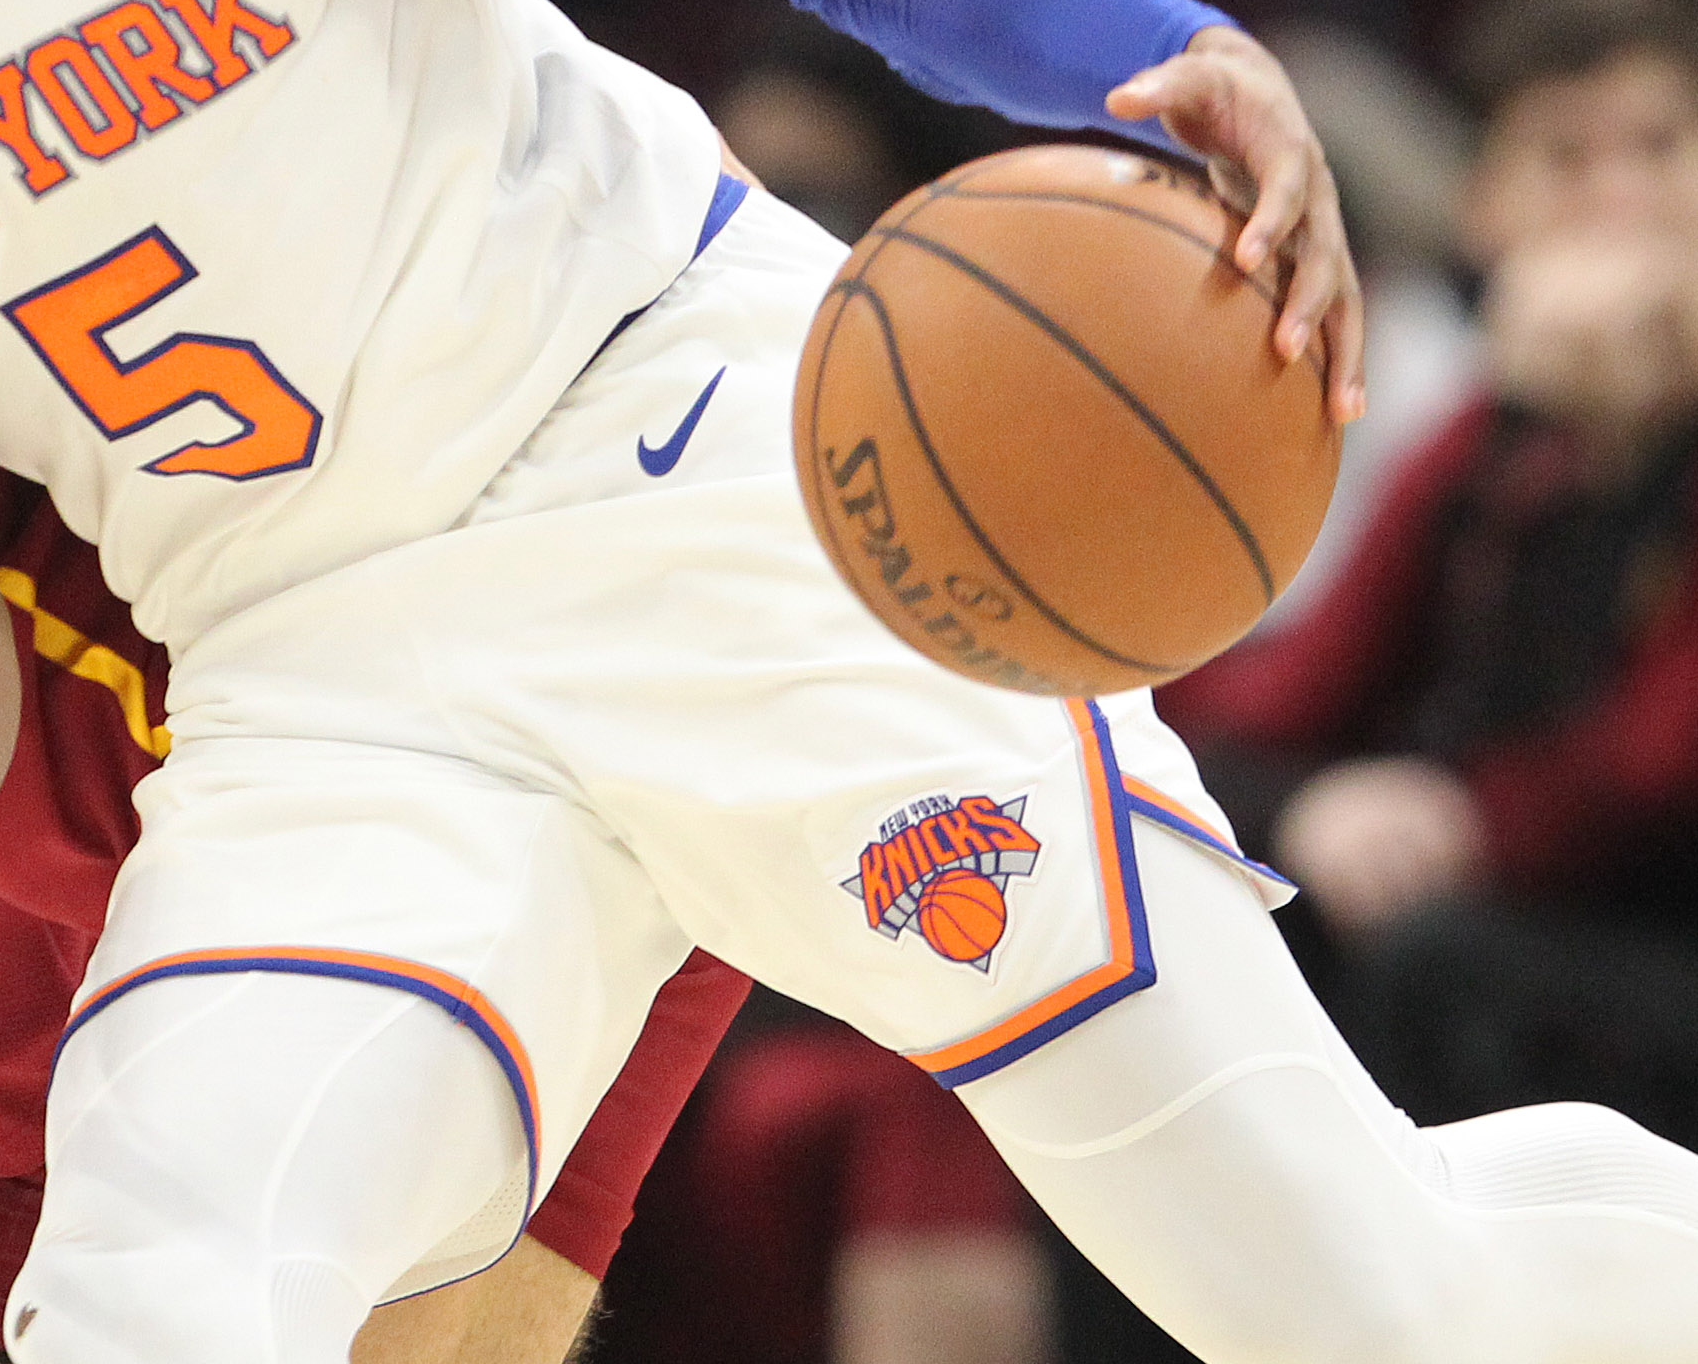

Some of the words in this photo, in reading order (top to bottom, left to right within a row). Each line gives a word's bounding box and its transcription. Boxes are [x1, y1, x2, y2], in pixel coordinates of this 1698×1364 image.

[858, 795, 1042, 931] KNICKS
[879, 808, 909, 843] NEW
[908, 794, 957, 820] YORK
